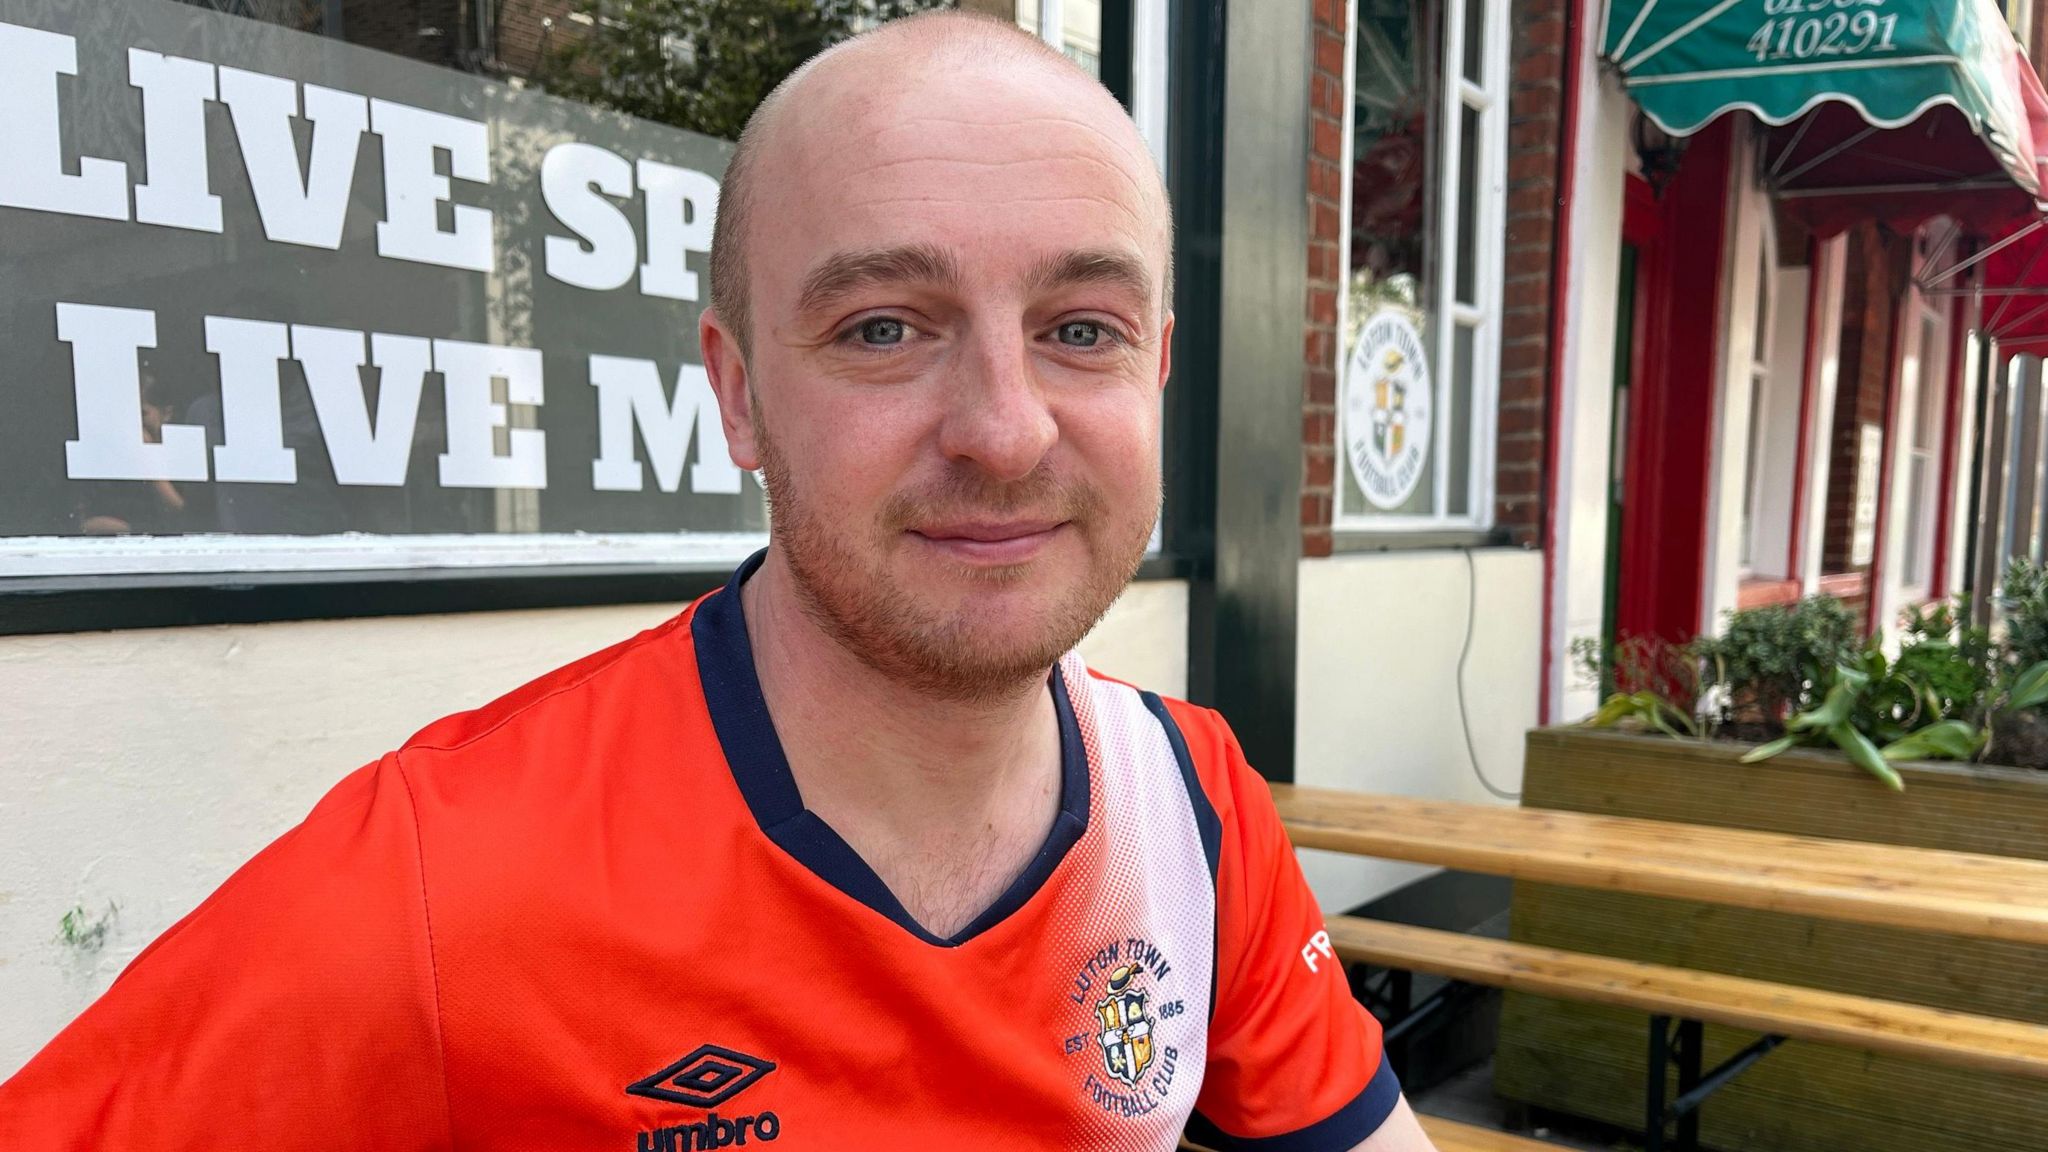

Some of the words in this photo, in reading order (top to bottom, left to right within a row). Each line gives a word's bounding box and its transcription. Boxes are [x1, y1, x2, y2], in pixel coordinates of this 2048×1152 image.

[1746, 9, 1899, 62] 410291
[0, 22, 496, 272] LIVE
[56, 302, 547, 489] LIVE
[588, 353, 767, 495] M
[1071, 940, 1120, 1005] LUTON
[1127, 938, 1171, 982] TOWN
[1065, 1032, 1090, 1055] EST
[1158, 1000, 1184, 1020] 1885
[1084, 1074, 1159, 1118] FOOTBALL
[1152, 1045, 1178, 1097] CLUB
[637, 1111, 780, 1152] umbro
